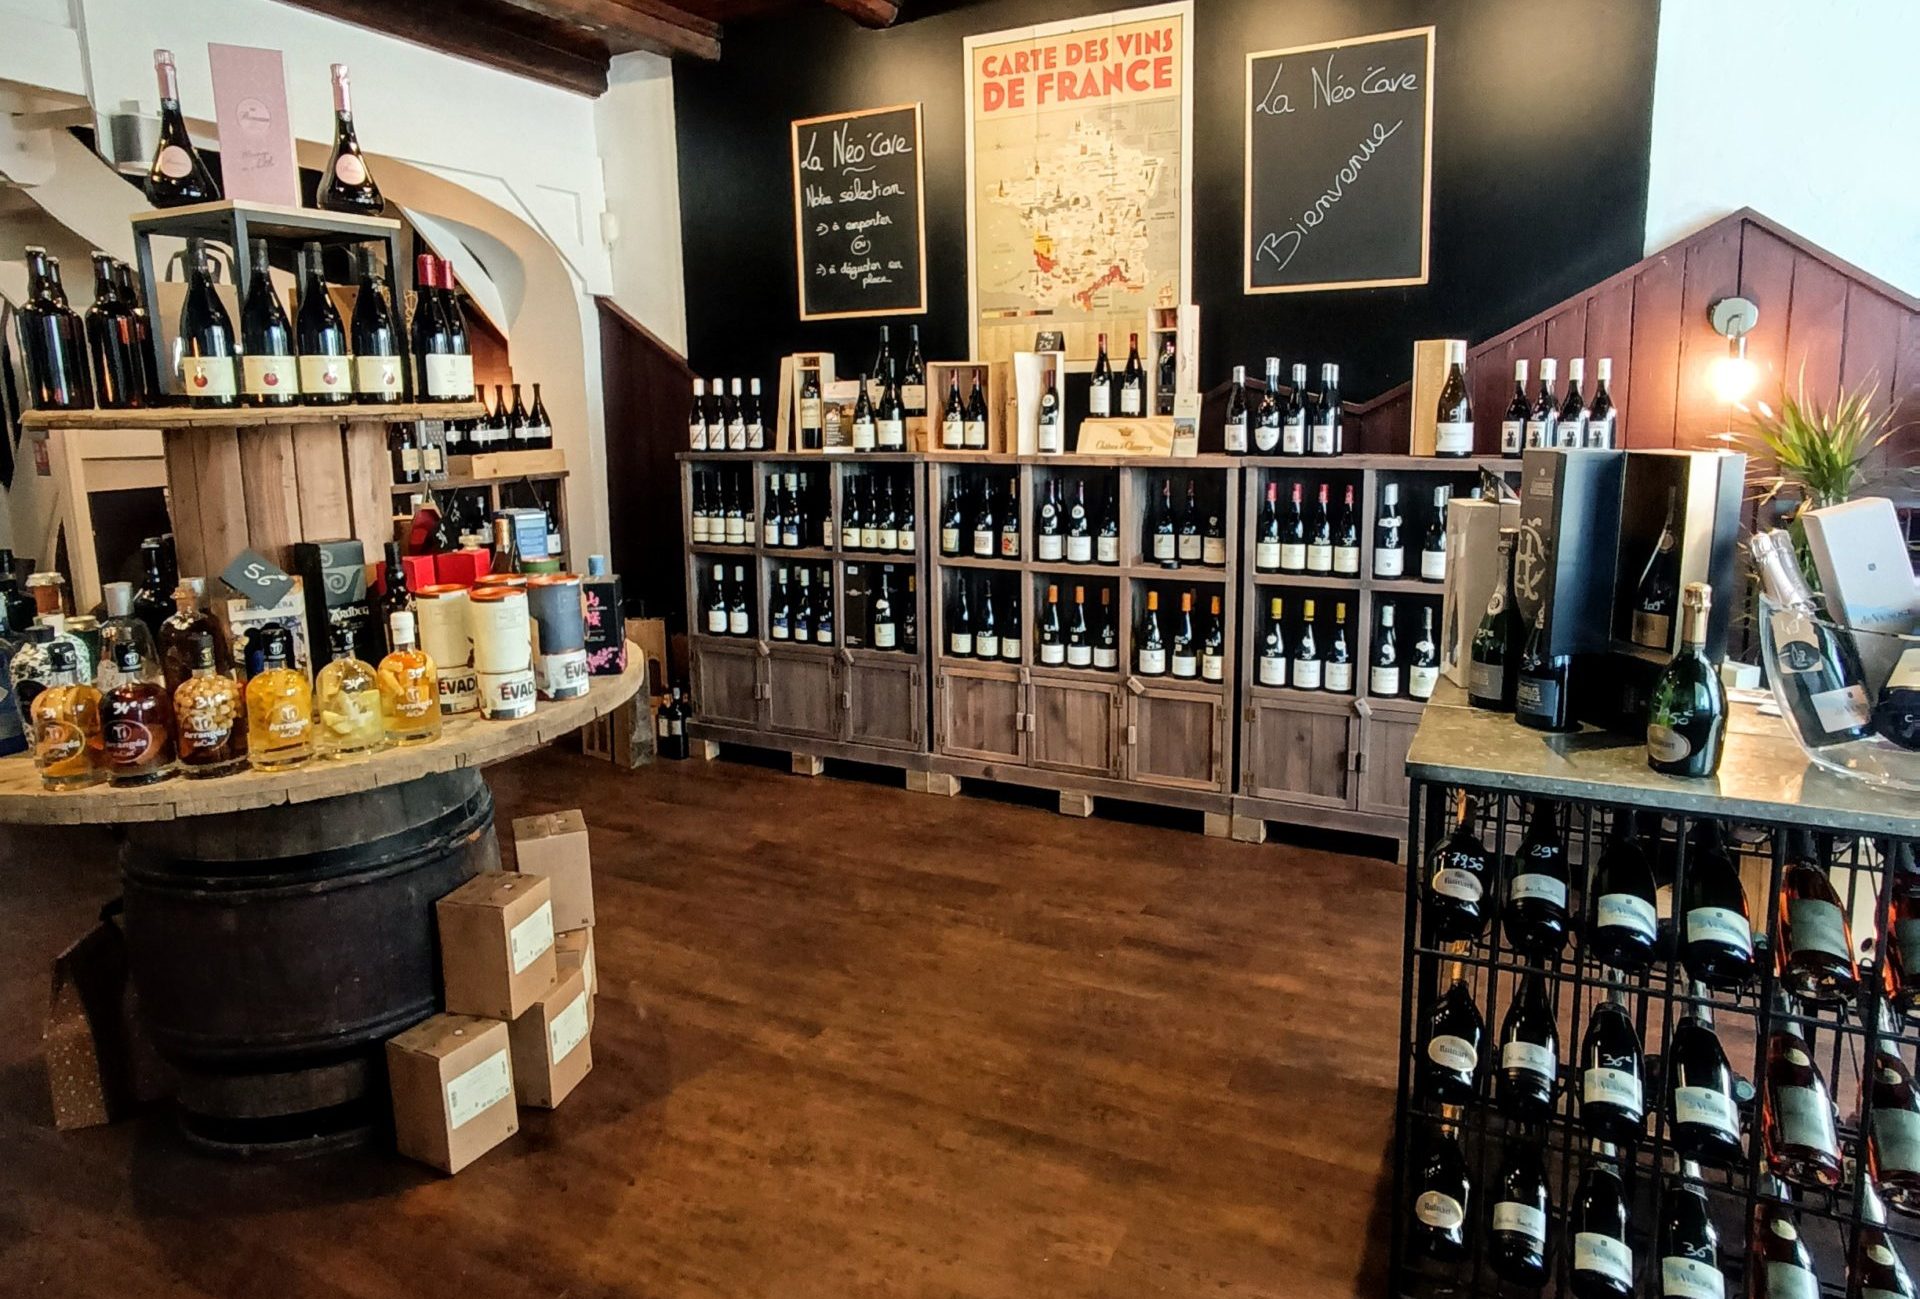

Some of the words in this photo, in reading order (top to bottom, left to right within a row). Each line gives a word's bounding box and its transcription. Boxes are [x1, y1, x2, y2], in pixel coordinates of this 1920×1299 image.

[982, 46, 1057, 78] CARTE
[1066, 37, 1109, 66] DES
[1117, 28, 1173, 57] VINS
[983, 77, 1025, 112] DE
[1037, 56, 1173, 105] FRANCE
[1256, 62, 1296, 115] La
[801, 132, 824, 171] La
[806, 184, 833, 208] Notre
[839, 178, 905, 203] sélection
[1256, 119, 1403, 271] Bienvenue
